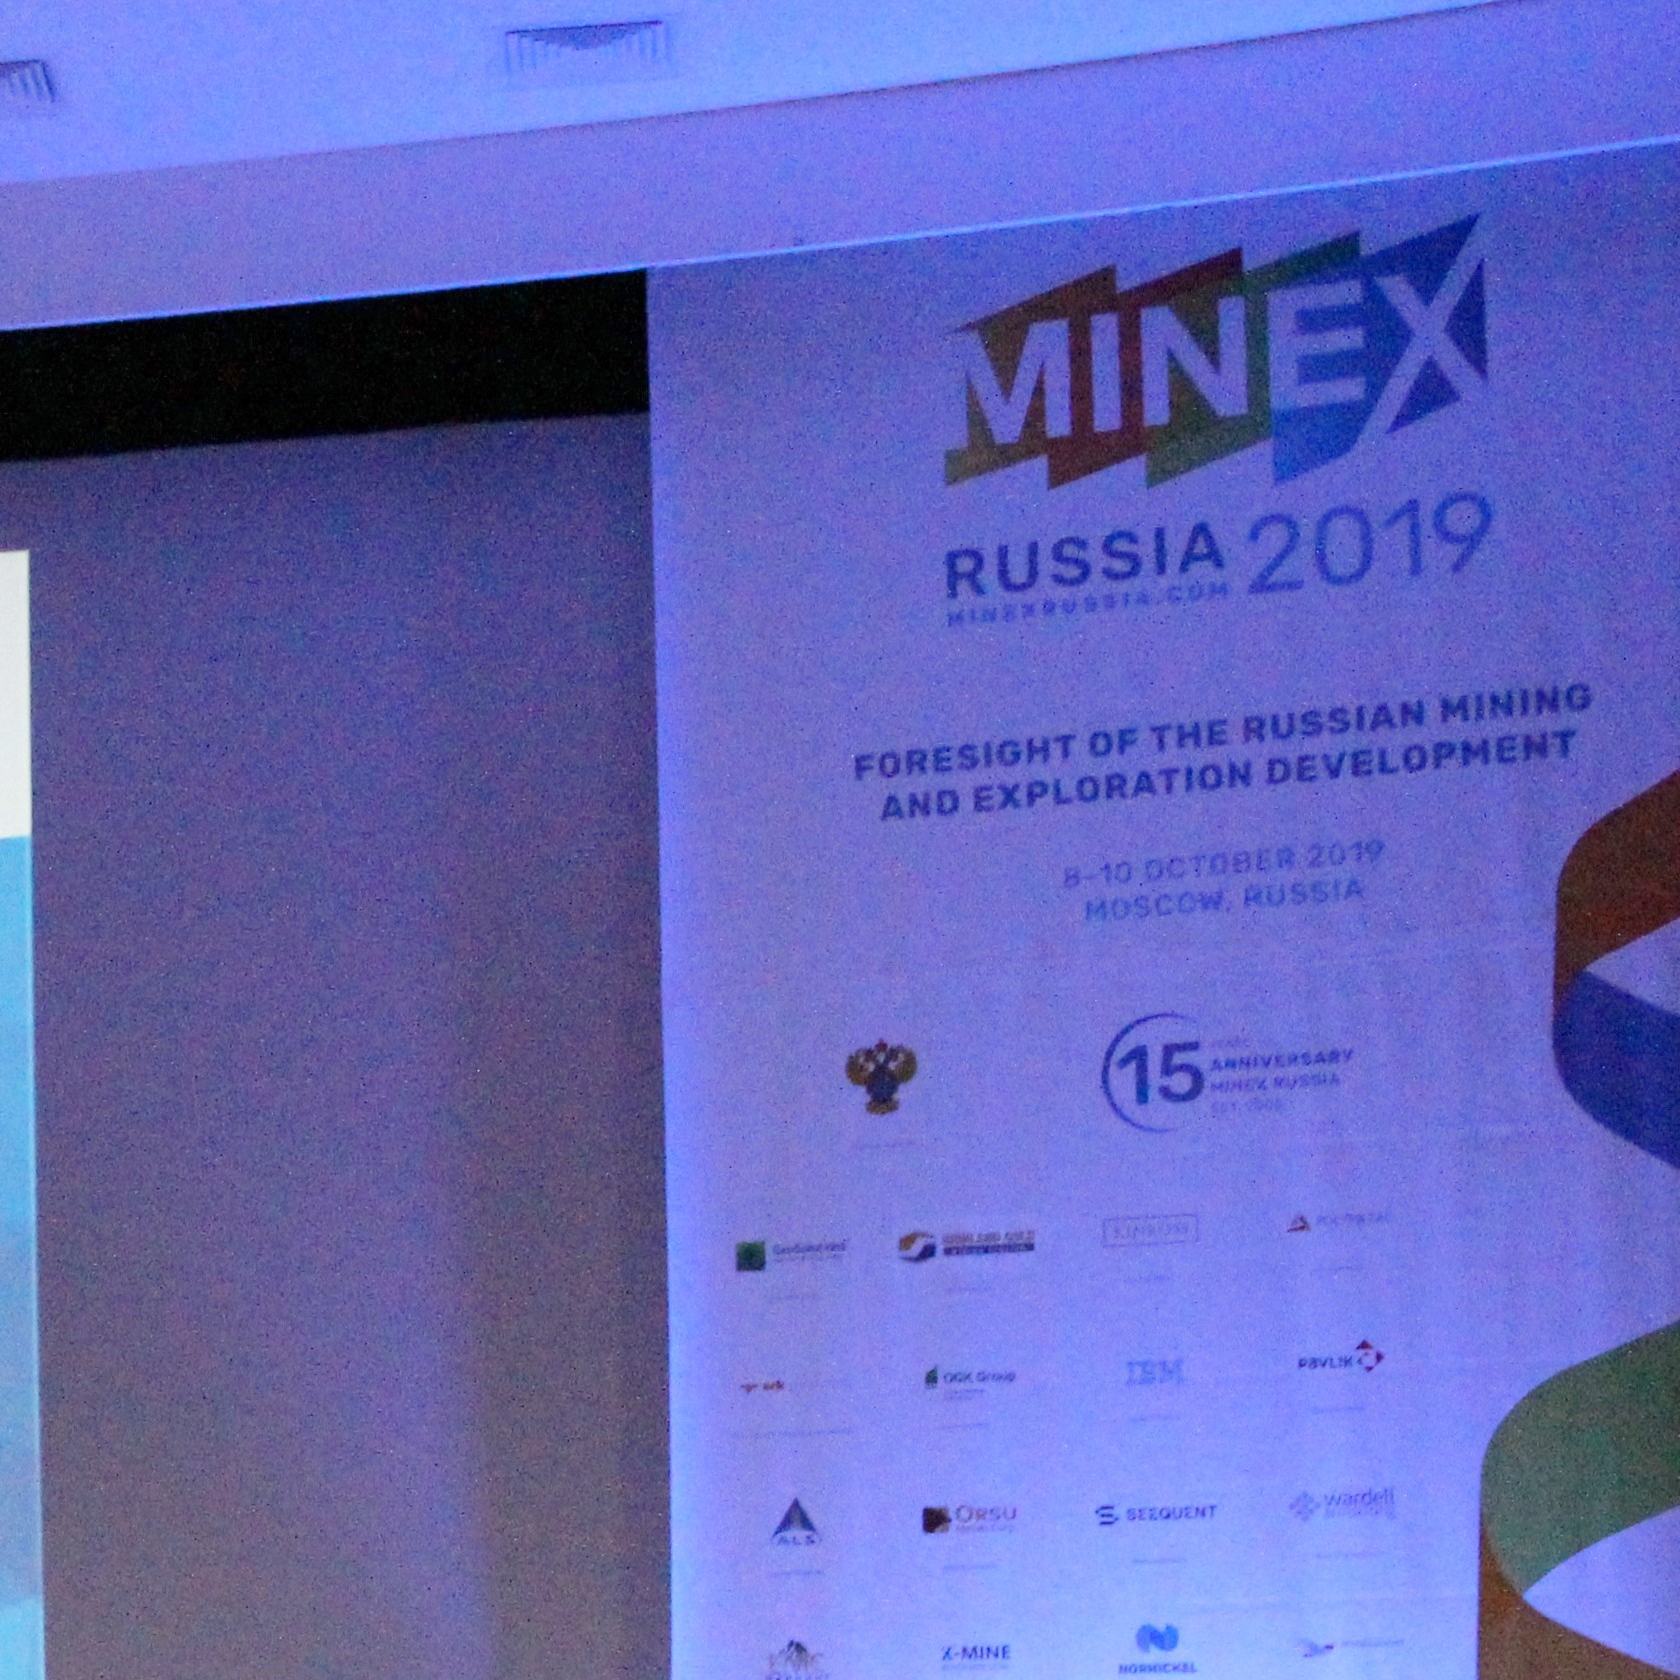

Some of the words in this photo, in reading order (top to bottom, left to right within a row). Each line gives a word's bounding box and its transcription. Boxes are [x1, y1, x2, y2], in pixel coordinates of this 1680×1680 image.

[944, 211, 1488, 486] MINEX
[945, 520, 1227, 600] RUSSIA
[1247, 490, 1496, 596] 2019
[853, 732, 1076, 782] FORESIGHT
[1089, 727, 1139, 758] OF
[1149, 718, 1229, 753] THE
[1241, 699, 1425, 744] RUSSIAN
[1439, 683, 1594, 726] MINING
[879, 787, 960, 822] AND
[973, 760, 1253, 815] EXPLORATION
[1265, 730, 1578, 787] DEVELOPMENT
[1144, 848, 1296, 882] OCTOBER
[1305, 840, 1386, 868] 2019
[1242, 878, 1364, 910] RUSSIA
[1117, 1040, 1206, 1105] 15
